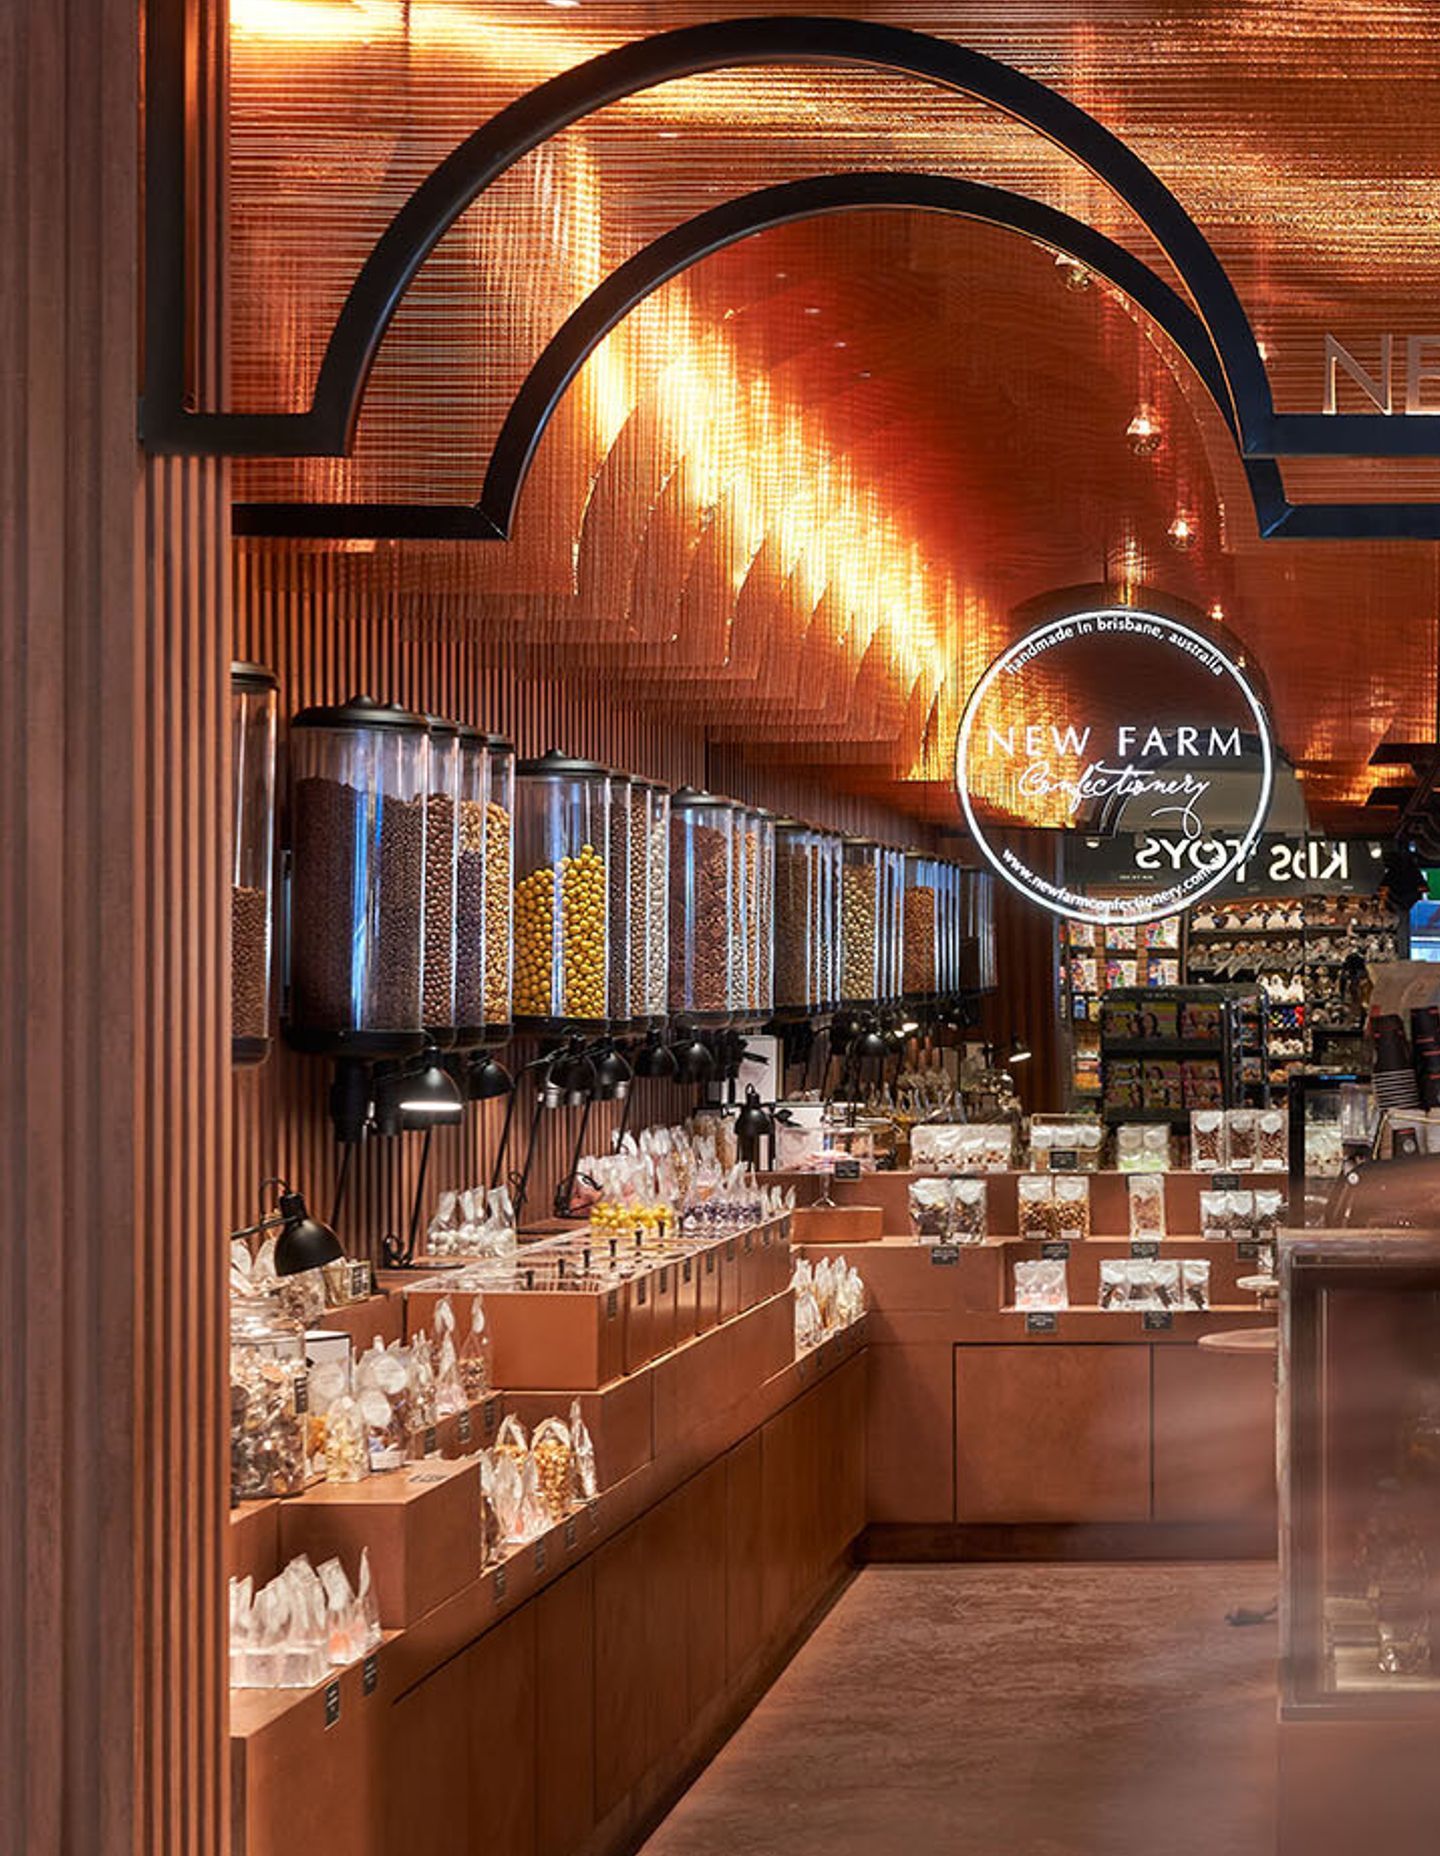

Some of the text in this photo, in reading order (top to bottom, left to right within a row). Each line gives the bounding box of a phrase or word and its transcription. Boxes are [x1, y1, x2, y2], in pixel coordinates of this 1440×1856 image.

[1004, 617, 1224, 676] handmade in brisbane, australia
[987, 726, 1242, 757] NEW FARM
[1018, 760, 1211, 839] Confectionery
